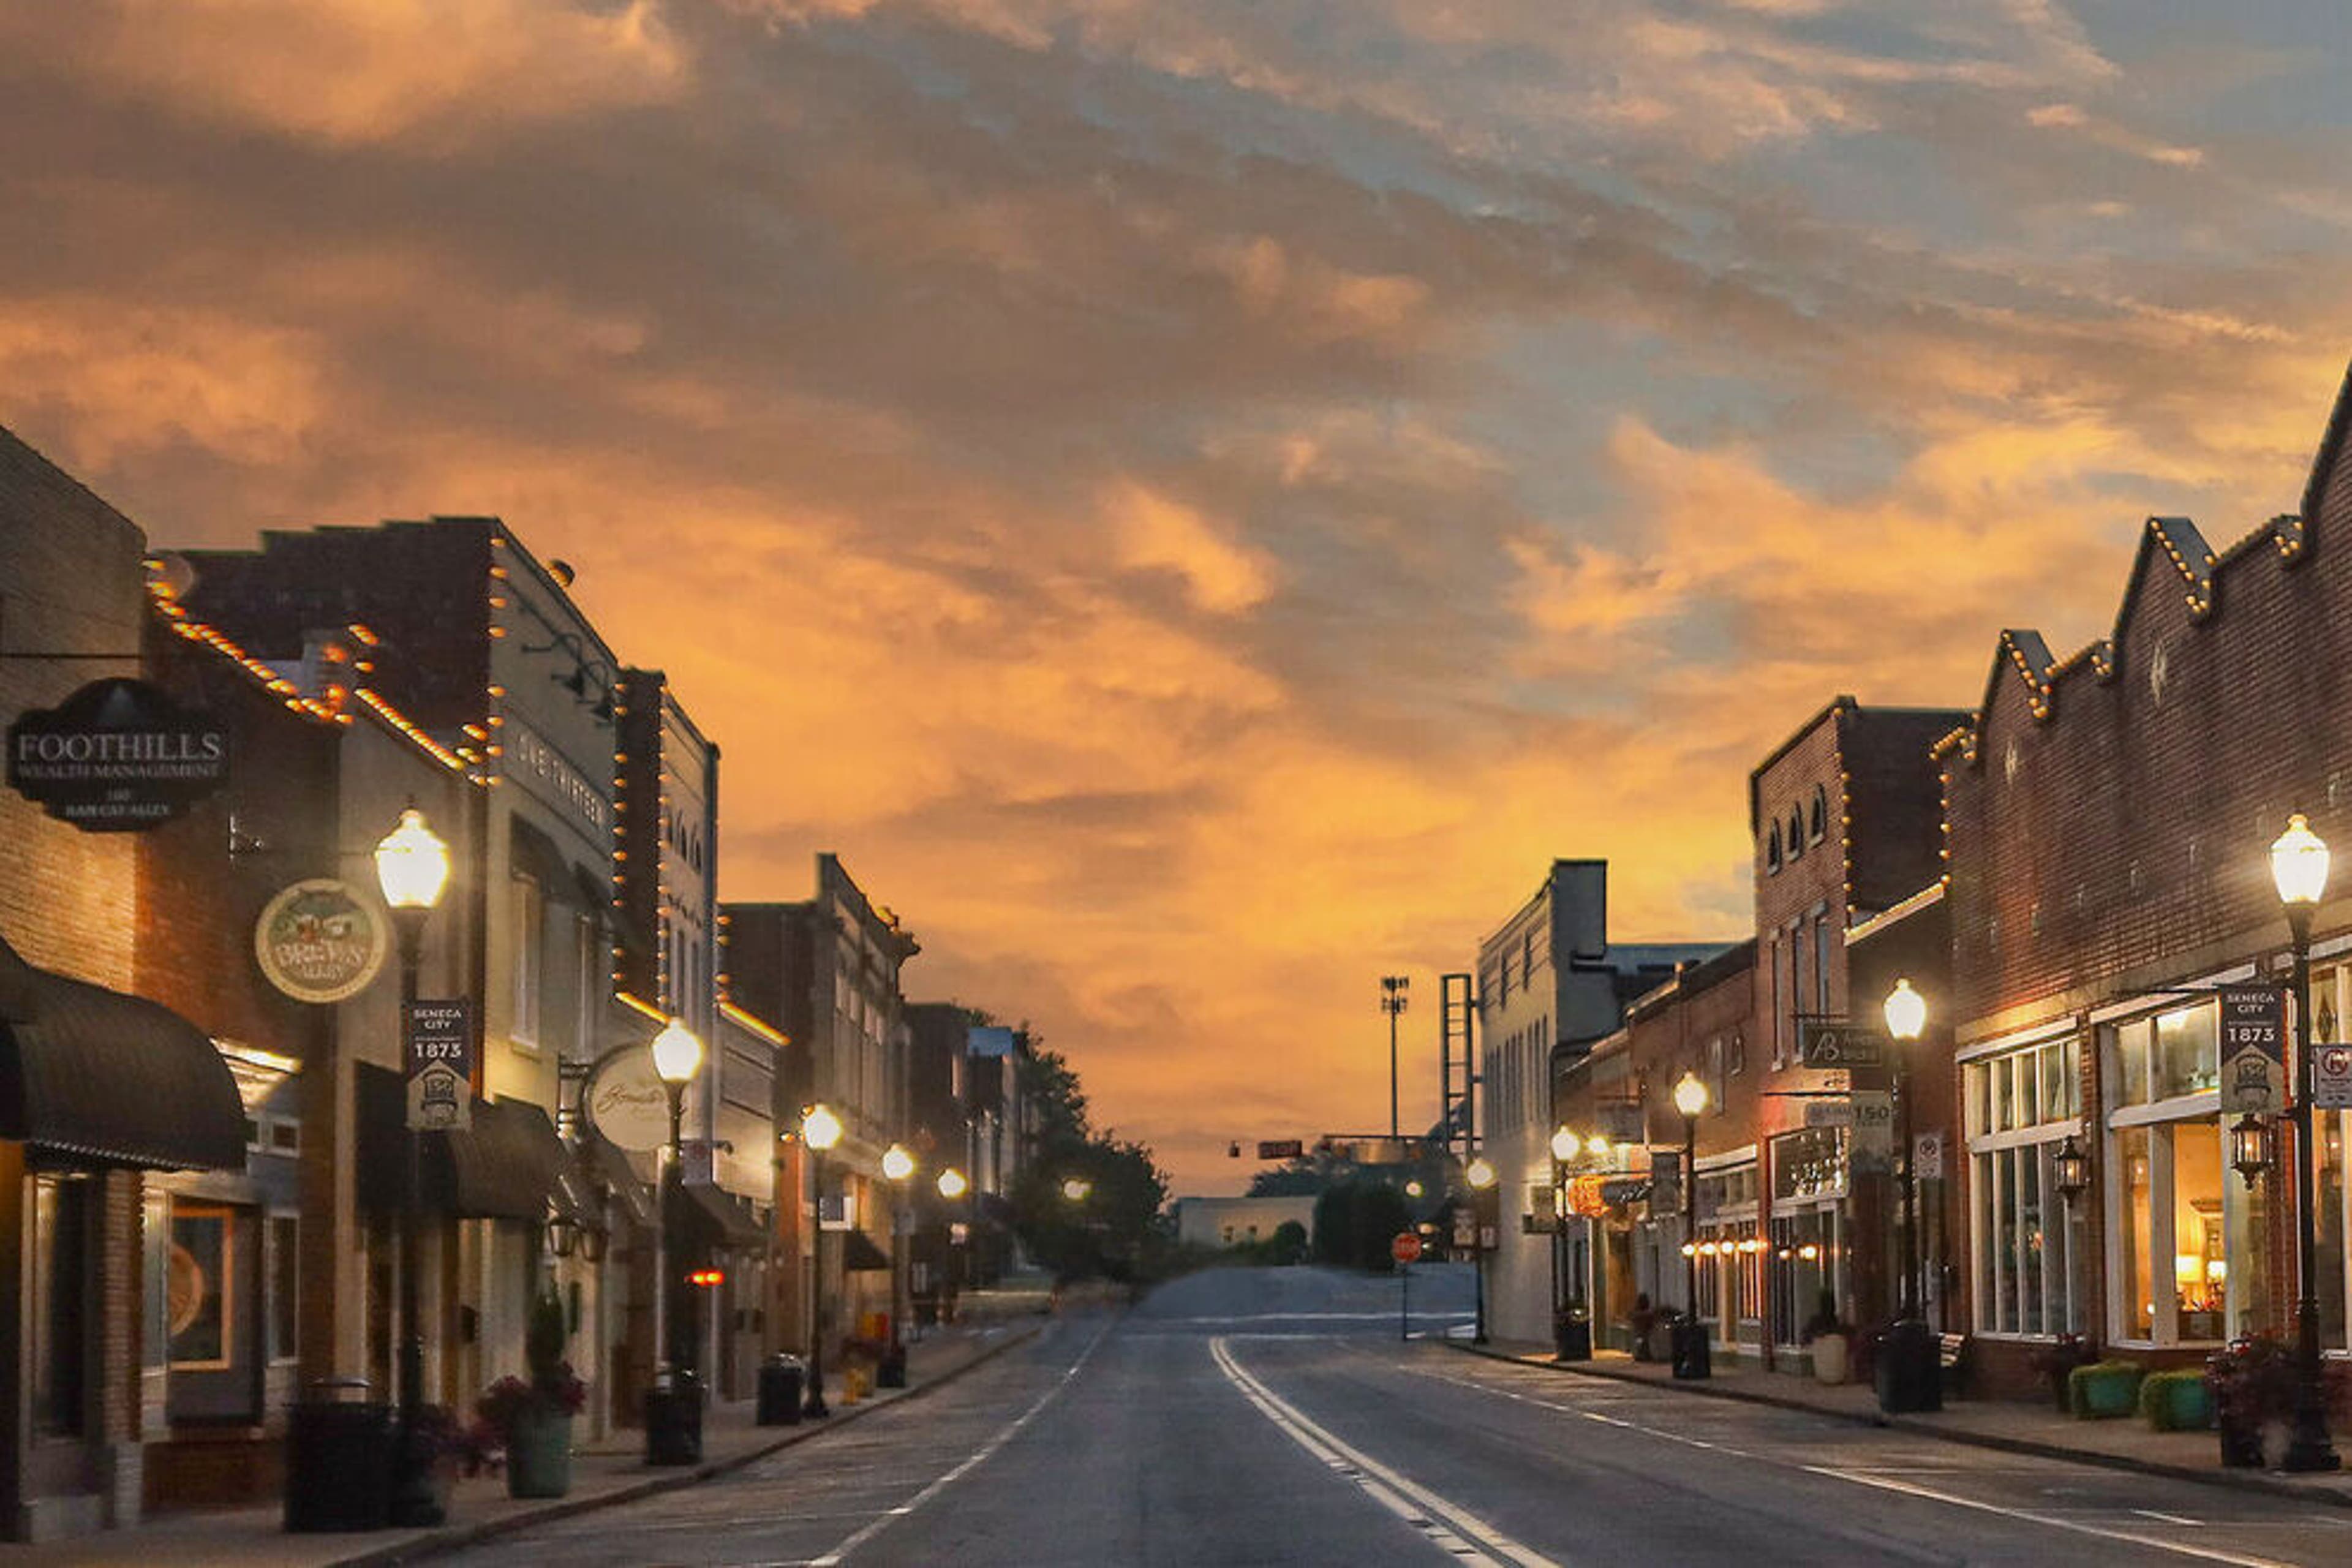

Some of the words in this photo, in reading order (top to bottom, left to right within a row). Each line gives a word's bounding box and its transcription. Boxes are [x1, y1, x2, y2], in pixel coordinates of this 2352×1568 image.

[18, 733, 221, 761] FOOTHILLS
[18, 764, 89, 778] WEALTH
[93, 764, 219, 778] MANAGEMENT
[2227, 992, 2275, 1003] SENECA
[414, 1008, 462, 1018] SENECA
[2237, 1004, 2265, 1013] CITY
[424, 1019, 451, 1029] CITY
